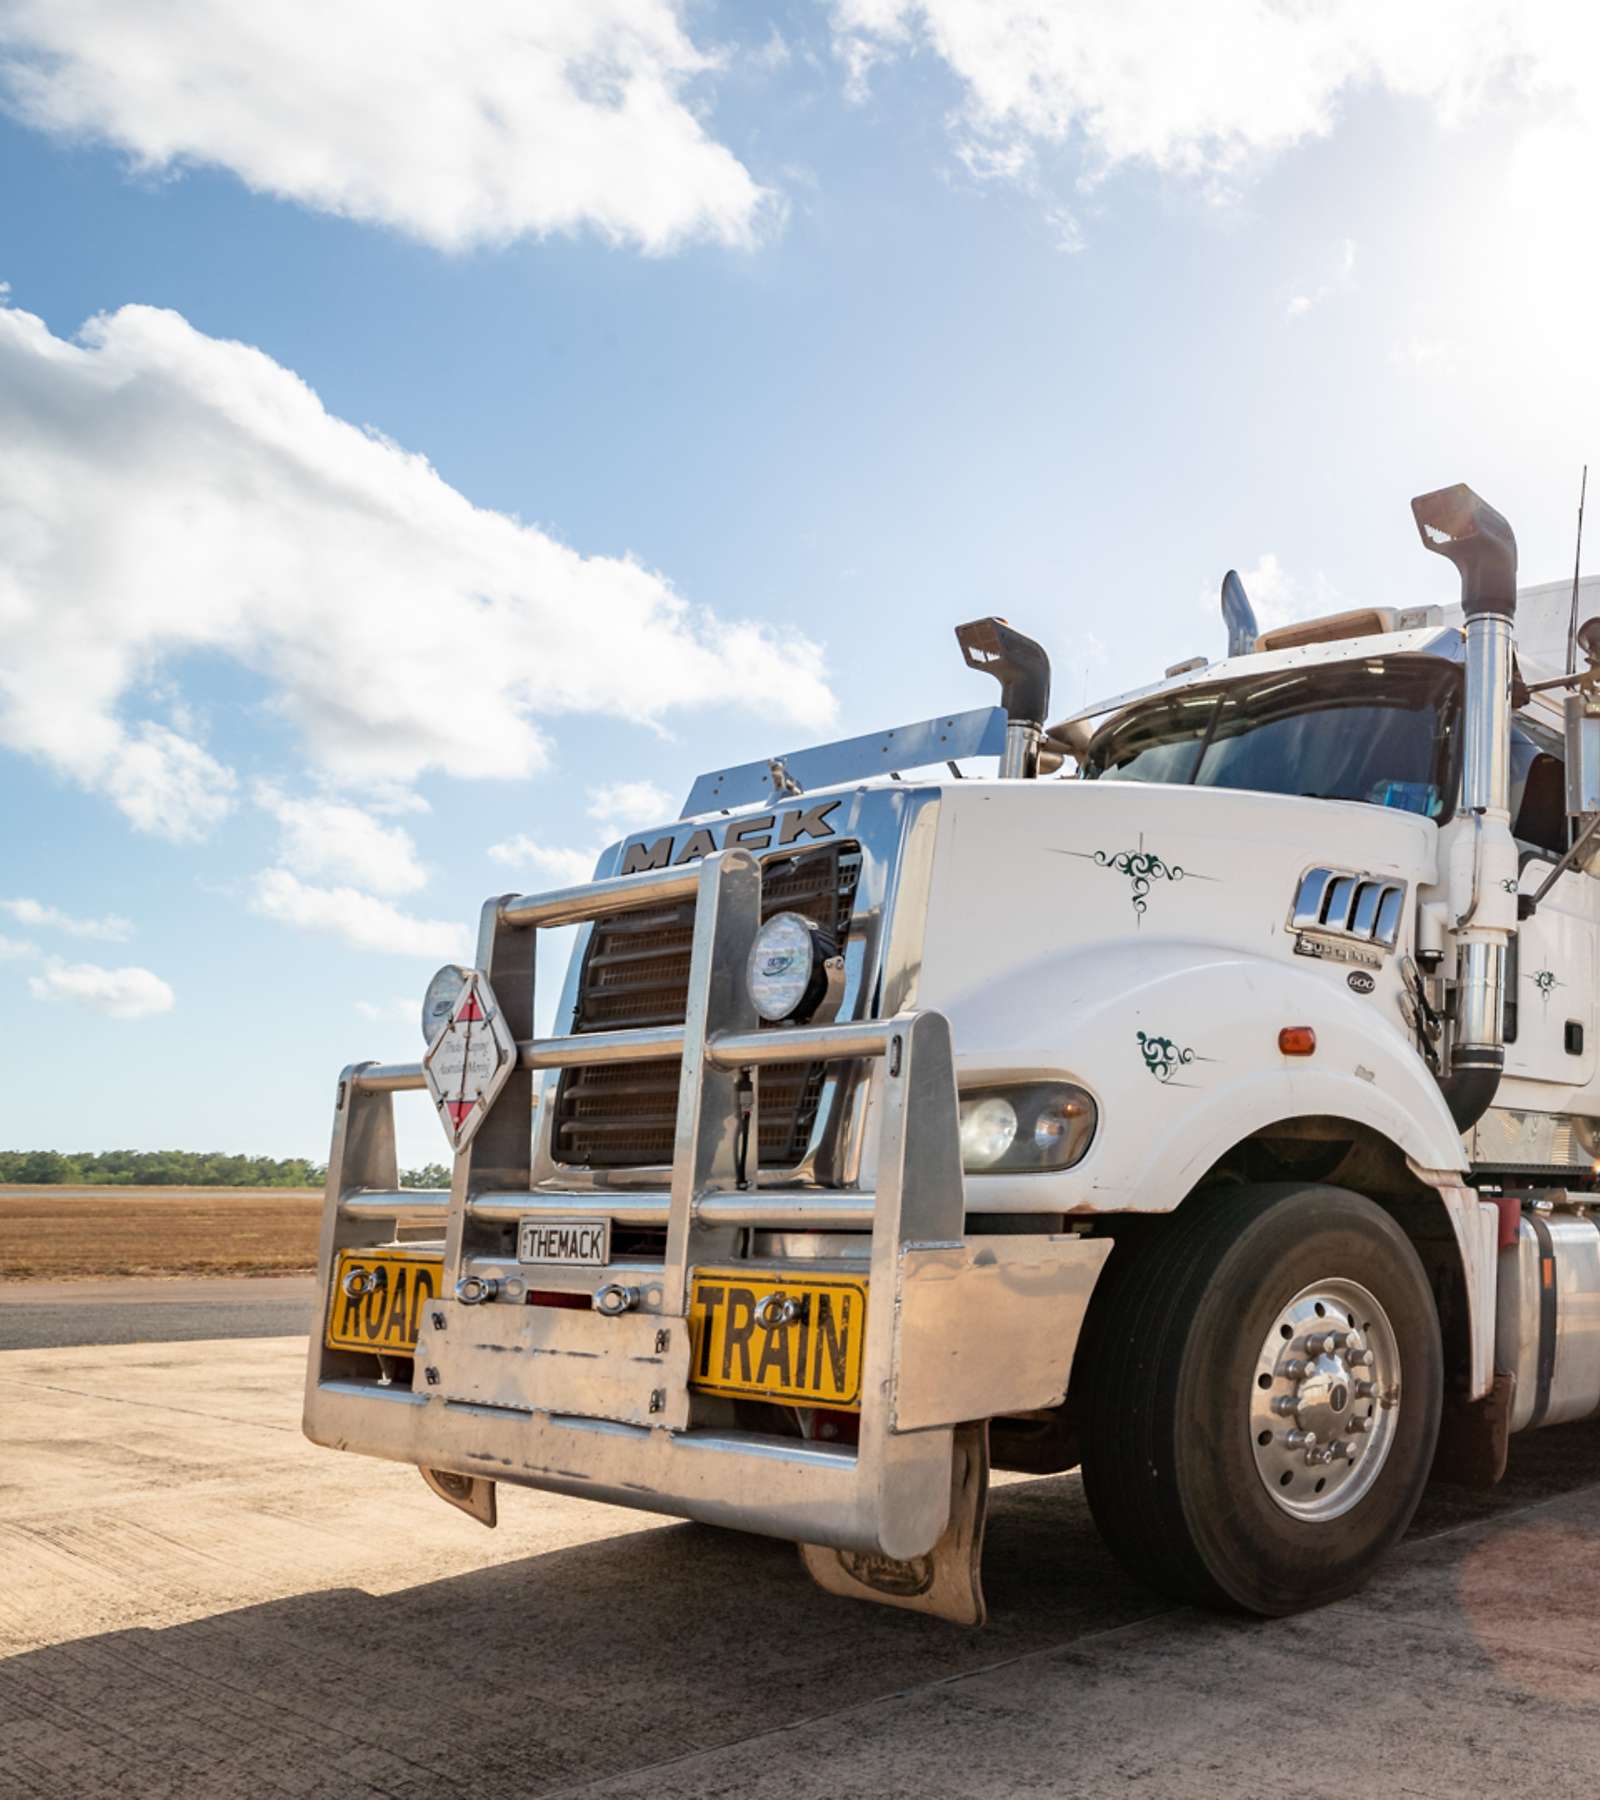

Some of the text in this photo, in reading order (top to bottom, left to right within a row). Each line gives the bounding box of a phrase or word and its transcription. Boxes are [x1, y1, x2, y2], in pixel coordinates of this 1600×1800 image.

[621, 801, 842, 875] MACK
[1349, 976, 1375, 989] 600
[529, 1229, 602, 1259] THEMACK
[342, 1265, 851, 1393] ROAD TRAIN
